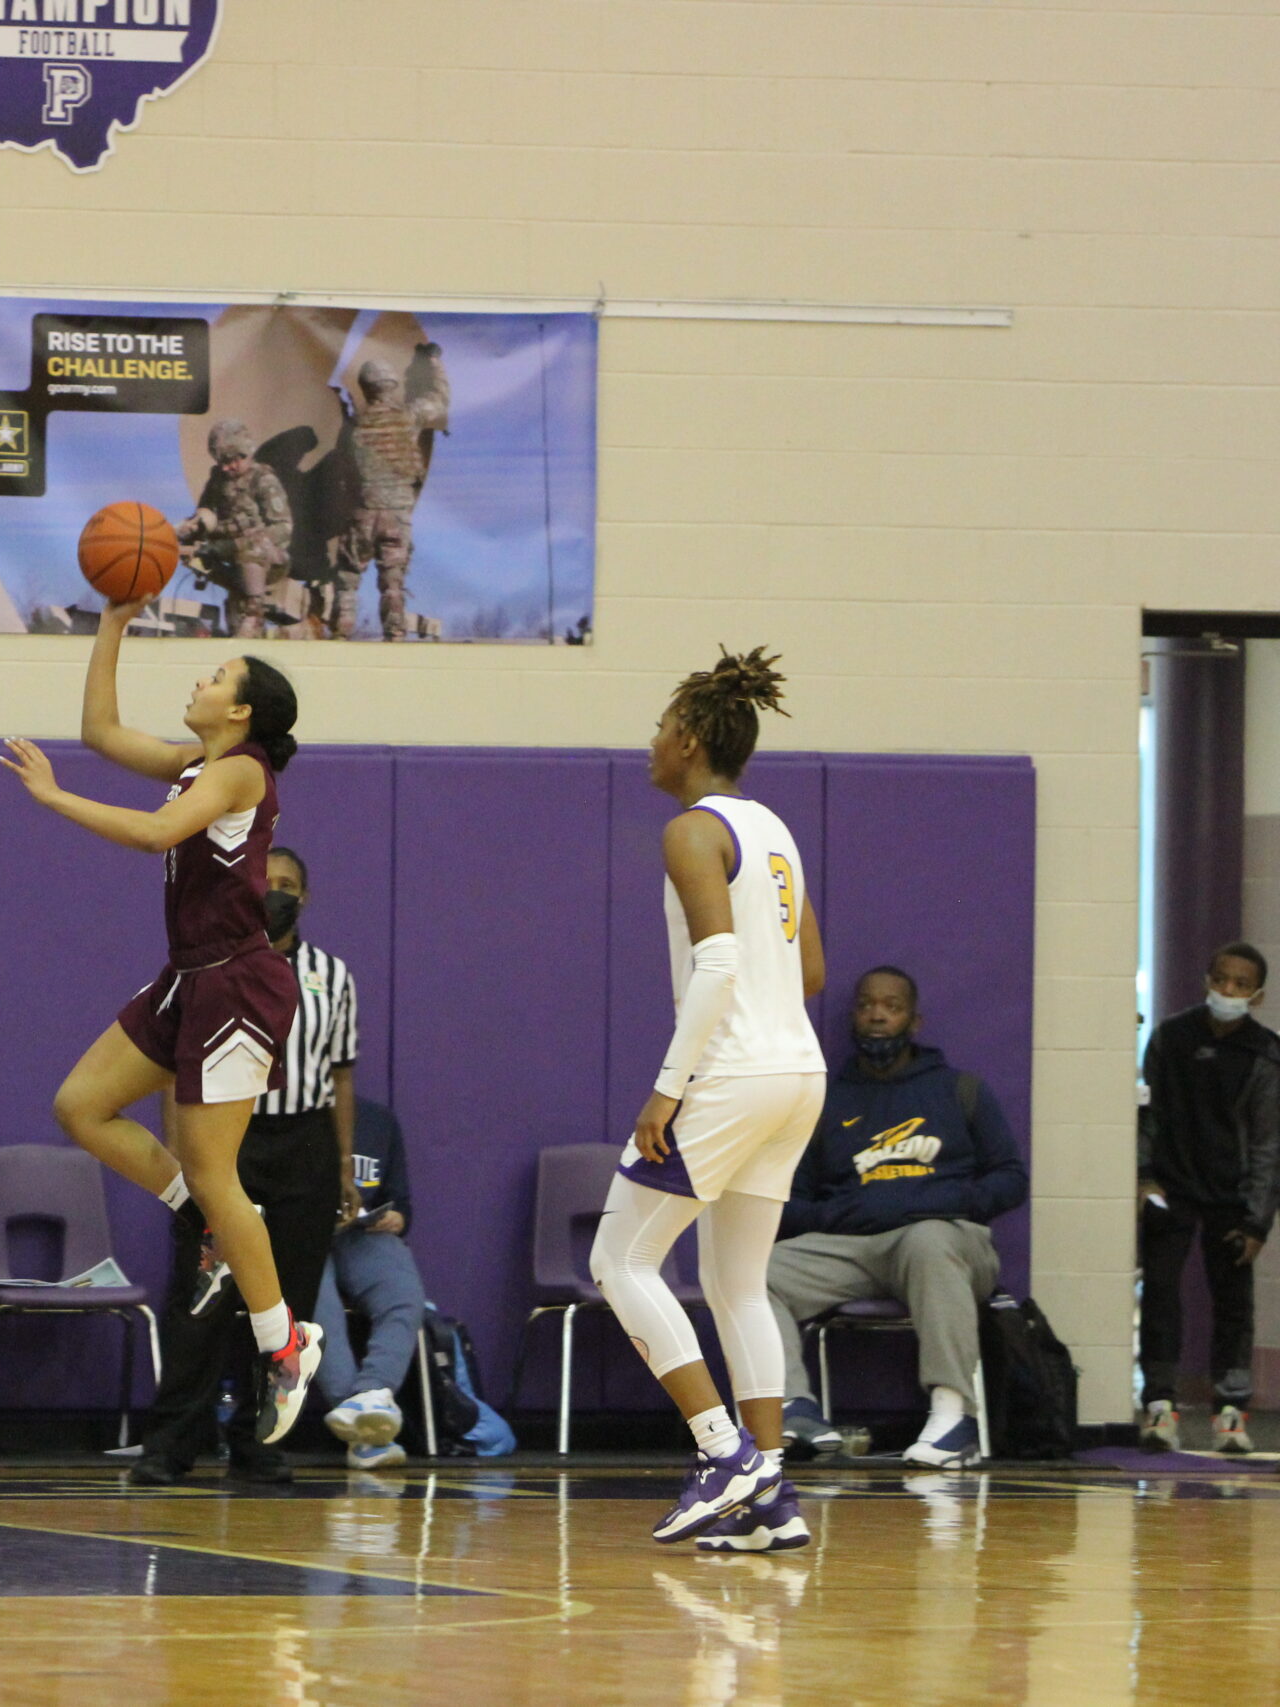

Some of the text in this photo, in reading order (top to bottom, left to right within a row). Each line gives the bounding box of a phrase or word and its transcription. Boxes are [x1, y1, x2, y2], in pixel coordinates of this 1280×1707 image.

[18, 29, 115, 57] FOOTBALL
[42, 62, 92, 125] P
[47, 331, 184, 355] RISE TO THE
[47, 356, 193, 380] CHALLENGE.
[768, 851, 800, 944] 3
